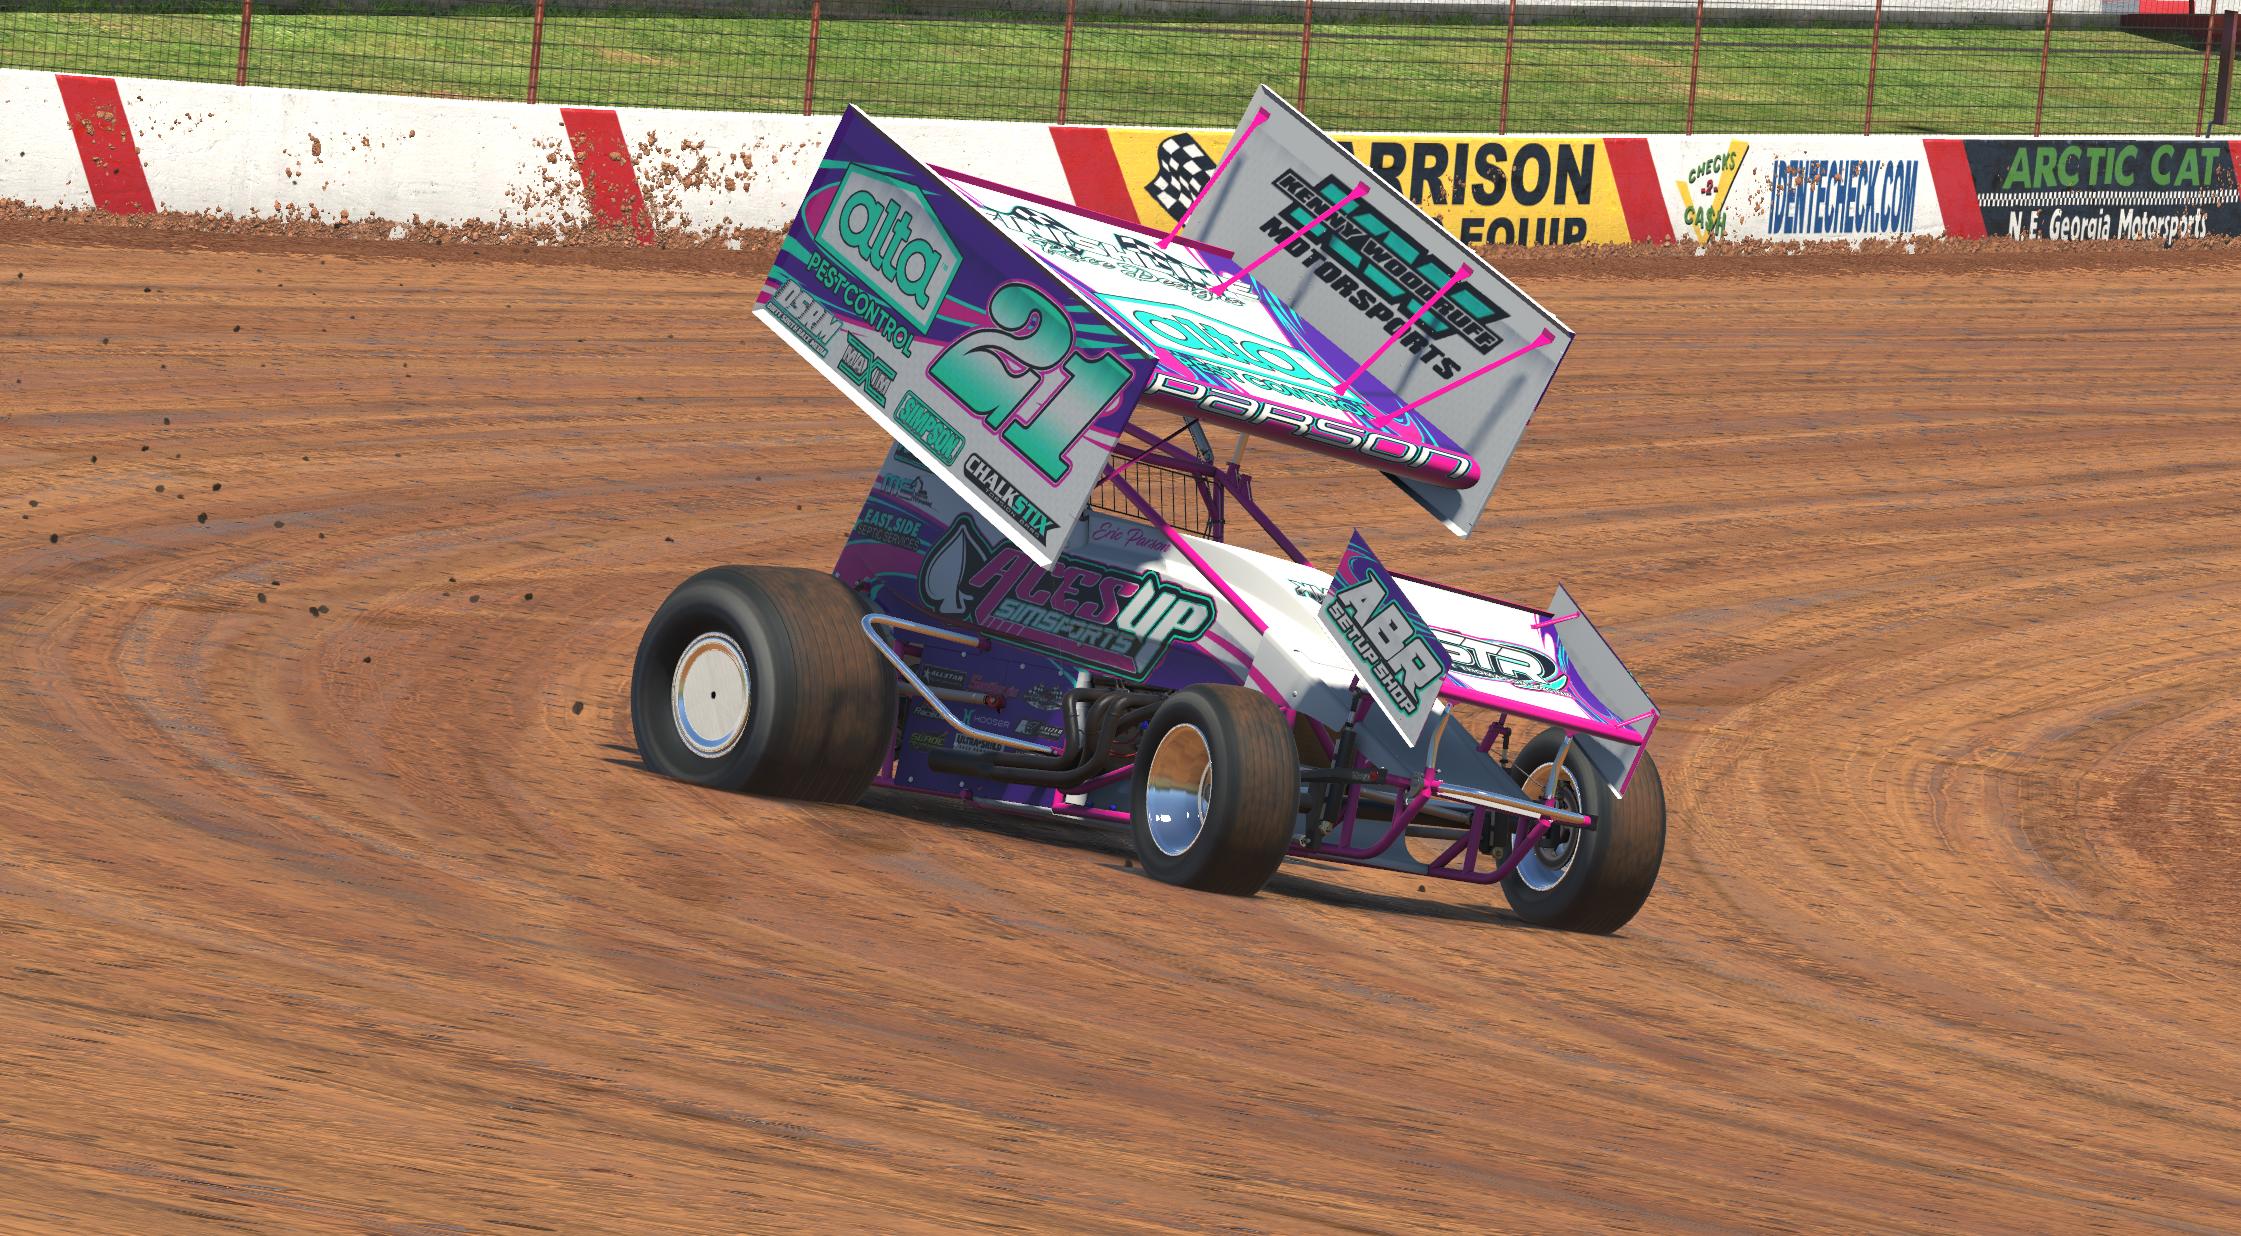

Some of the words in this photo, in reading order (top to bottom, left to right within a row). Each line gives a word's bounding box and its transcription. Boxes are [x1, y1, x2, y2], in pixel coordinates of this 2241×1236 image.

[1688, 151, 1736, 184] CHECKS
[1768, 160, 1918, 234] IDENTECHECK.COM
[2002, 145, 2139, 189] ARCTIC
[2151, 145, 2221, 187] CAT
[838, 190, 942, 310] alta
[1279, 175, 1367, 240] KENNY
[1362, 238, 1498, 350] WOODRUFF
[2049, 208, 2111, 241] Georgia
[2117, 208, 2208, 246] Motorsports
[807, 251, 850, 294] PEST
[843, 281, 915, 358] CONTROL
[1259, 216, 1462, 380] MOTORSPORTS
[899, 397, 961, 460] SIMPSON
[928, 281, 1134, 486] 21
[965, 456, 1054, 536] CHALKSTIX
[1328, 602, 1378, 664] SETUP
[1373, 663, 1417, 716] SHOP
[1337, 571, 1445, 704] ABR
